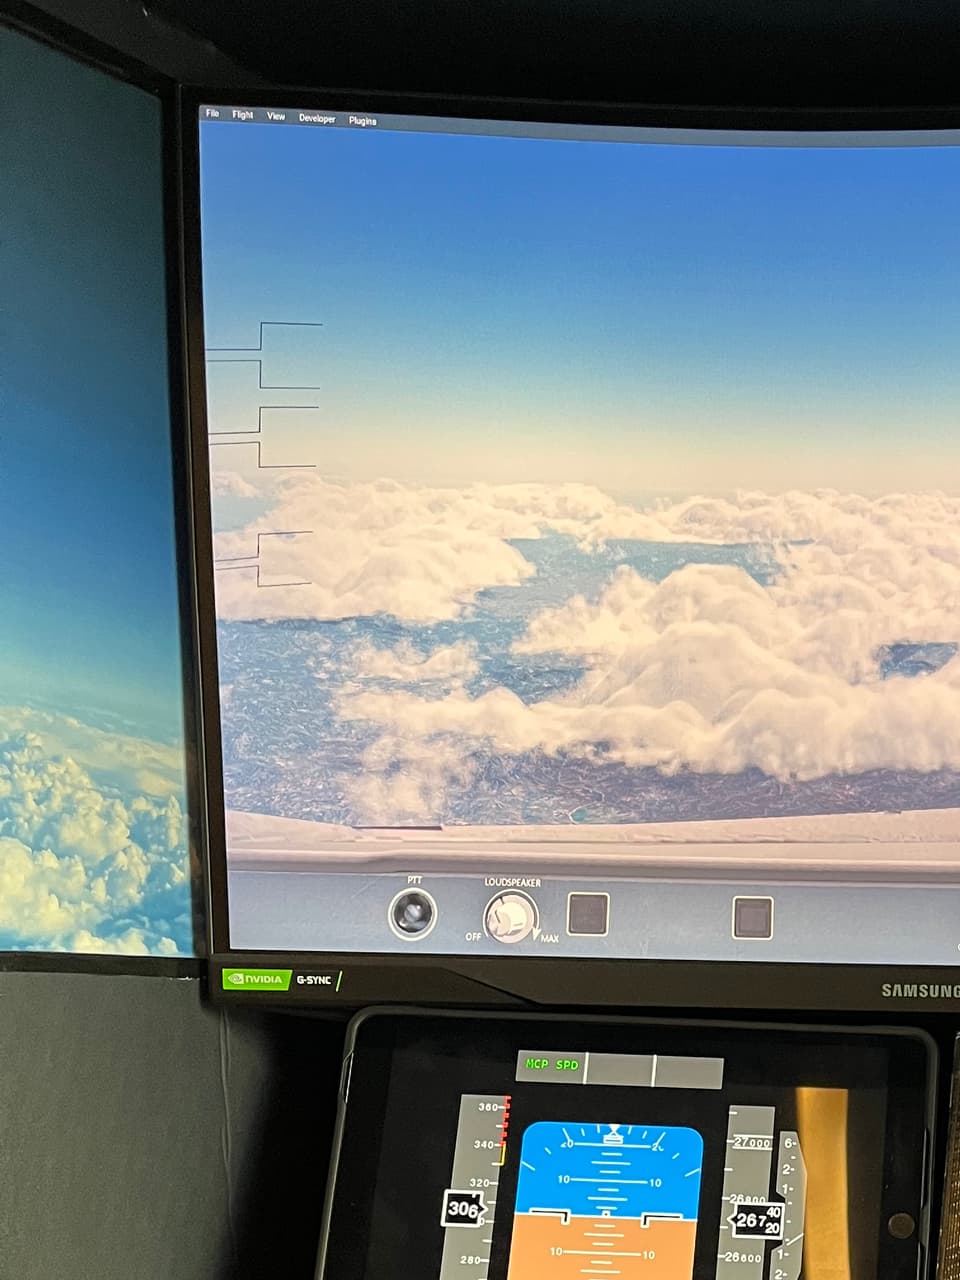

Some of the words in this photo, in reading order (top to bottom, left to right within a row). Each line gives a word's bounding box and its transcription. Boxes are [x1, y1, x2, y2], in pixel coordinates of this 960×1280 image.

[206, 109, 219, 118] File
[232, 110, 253, 121] Flight
[267, 112, 285, 122] View
[299, 113, 336, 125] Developer
[349, 116, 377, 127] Plugins
[407, 875, 422, 884] PTT
[484, 877, 541, 888] LOUDSPEAKER
[465, 932, 481, 942] OFF
[541, 934, 559, 944] MAX
[297, 975, 331, 985] G-SYNC
[526, 1058, 548, 1069] MCP
[556, 1060, 579, 1070] SPD
[478, 1103, 498, 1111] 360
[474, 1141, 494, 1149] 340
[734, 1137, 770, 1148] 27000
[784, 1139, 792, 1148] 6
[782, 1165, 791, 1174] 2
[469, 1179, 490, 1187] 320
[558, 1175, 570, 1184] 10
[650, 1179, 662, 1187] 10
[448, 1201, 479, 1219] 306
[767, 1207, 781, 1218] 40
[737, 1213, 766, 1228] 267
[765, 1222, 779, 1234] 20
[550, 1247, 562, 1256] 10
[643, 1251, 655, 1259] 10
[725, 1252, 761, 1263] 26600
[460, 1256, 481, 1265] 280
[775, 1270, 783, 1279] 2
